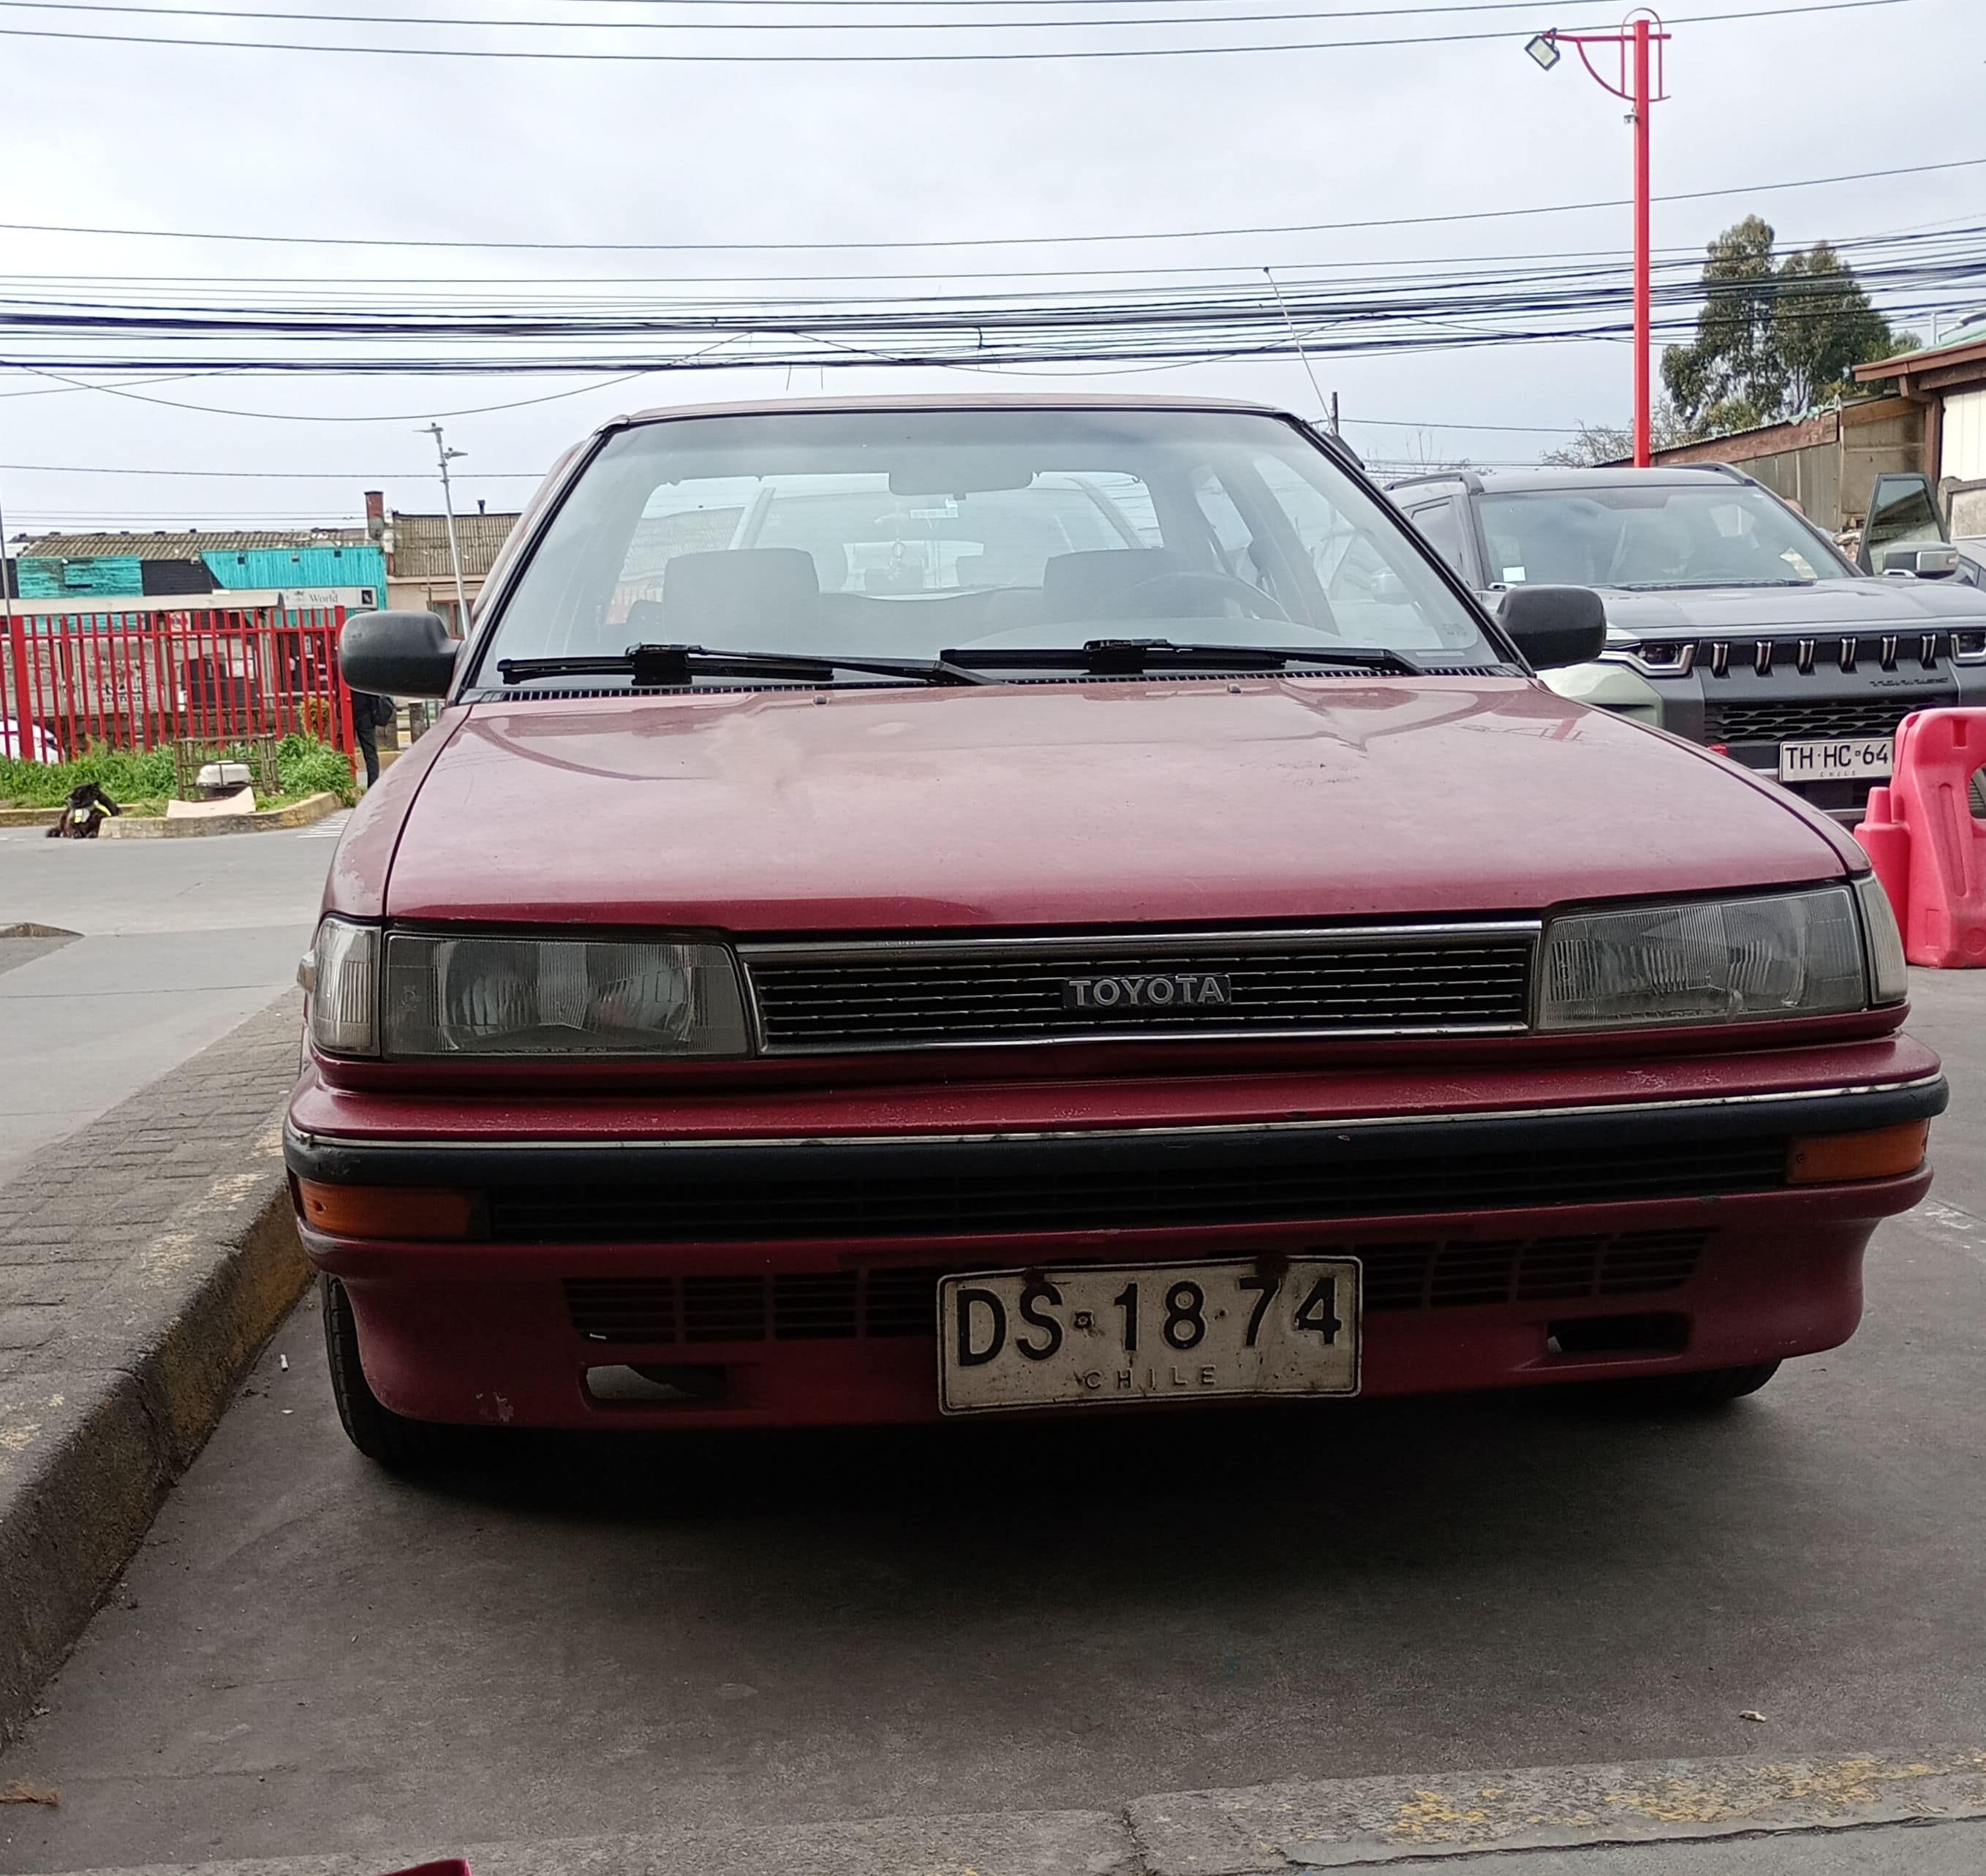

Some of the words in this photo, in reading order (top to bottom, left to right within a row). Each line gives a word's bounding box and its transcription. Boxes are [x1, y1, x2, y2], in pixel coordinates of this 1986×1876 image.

[309, 593, 338, 603] World
[1068, 977, 1225, 1006] TOYOTA
[1084, 1364, 1217, 1390] CHILE
